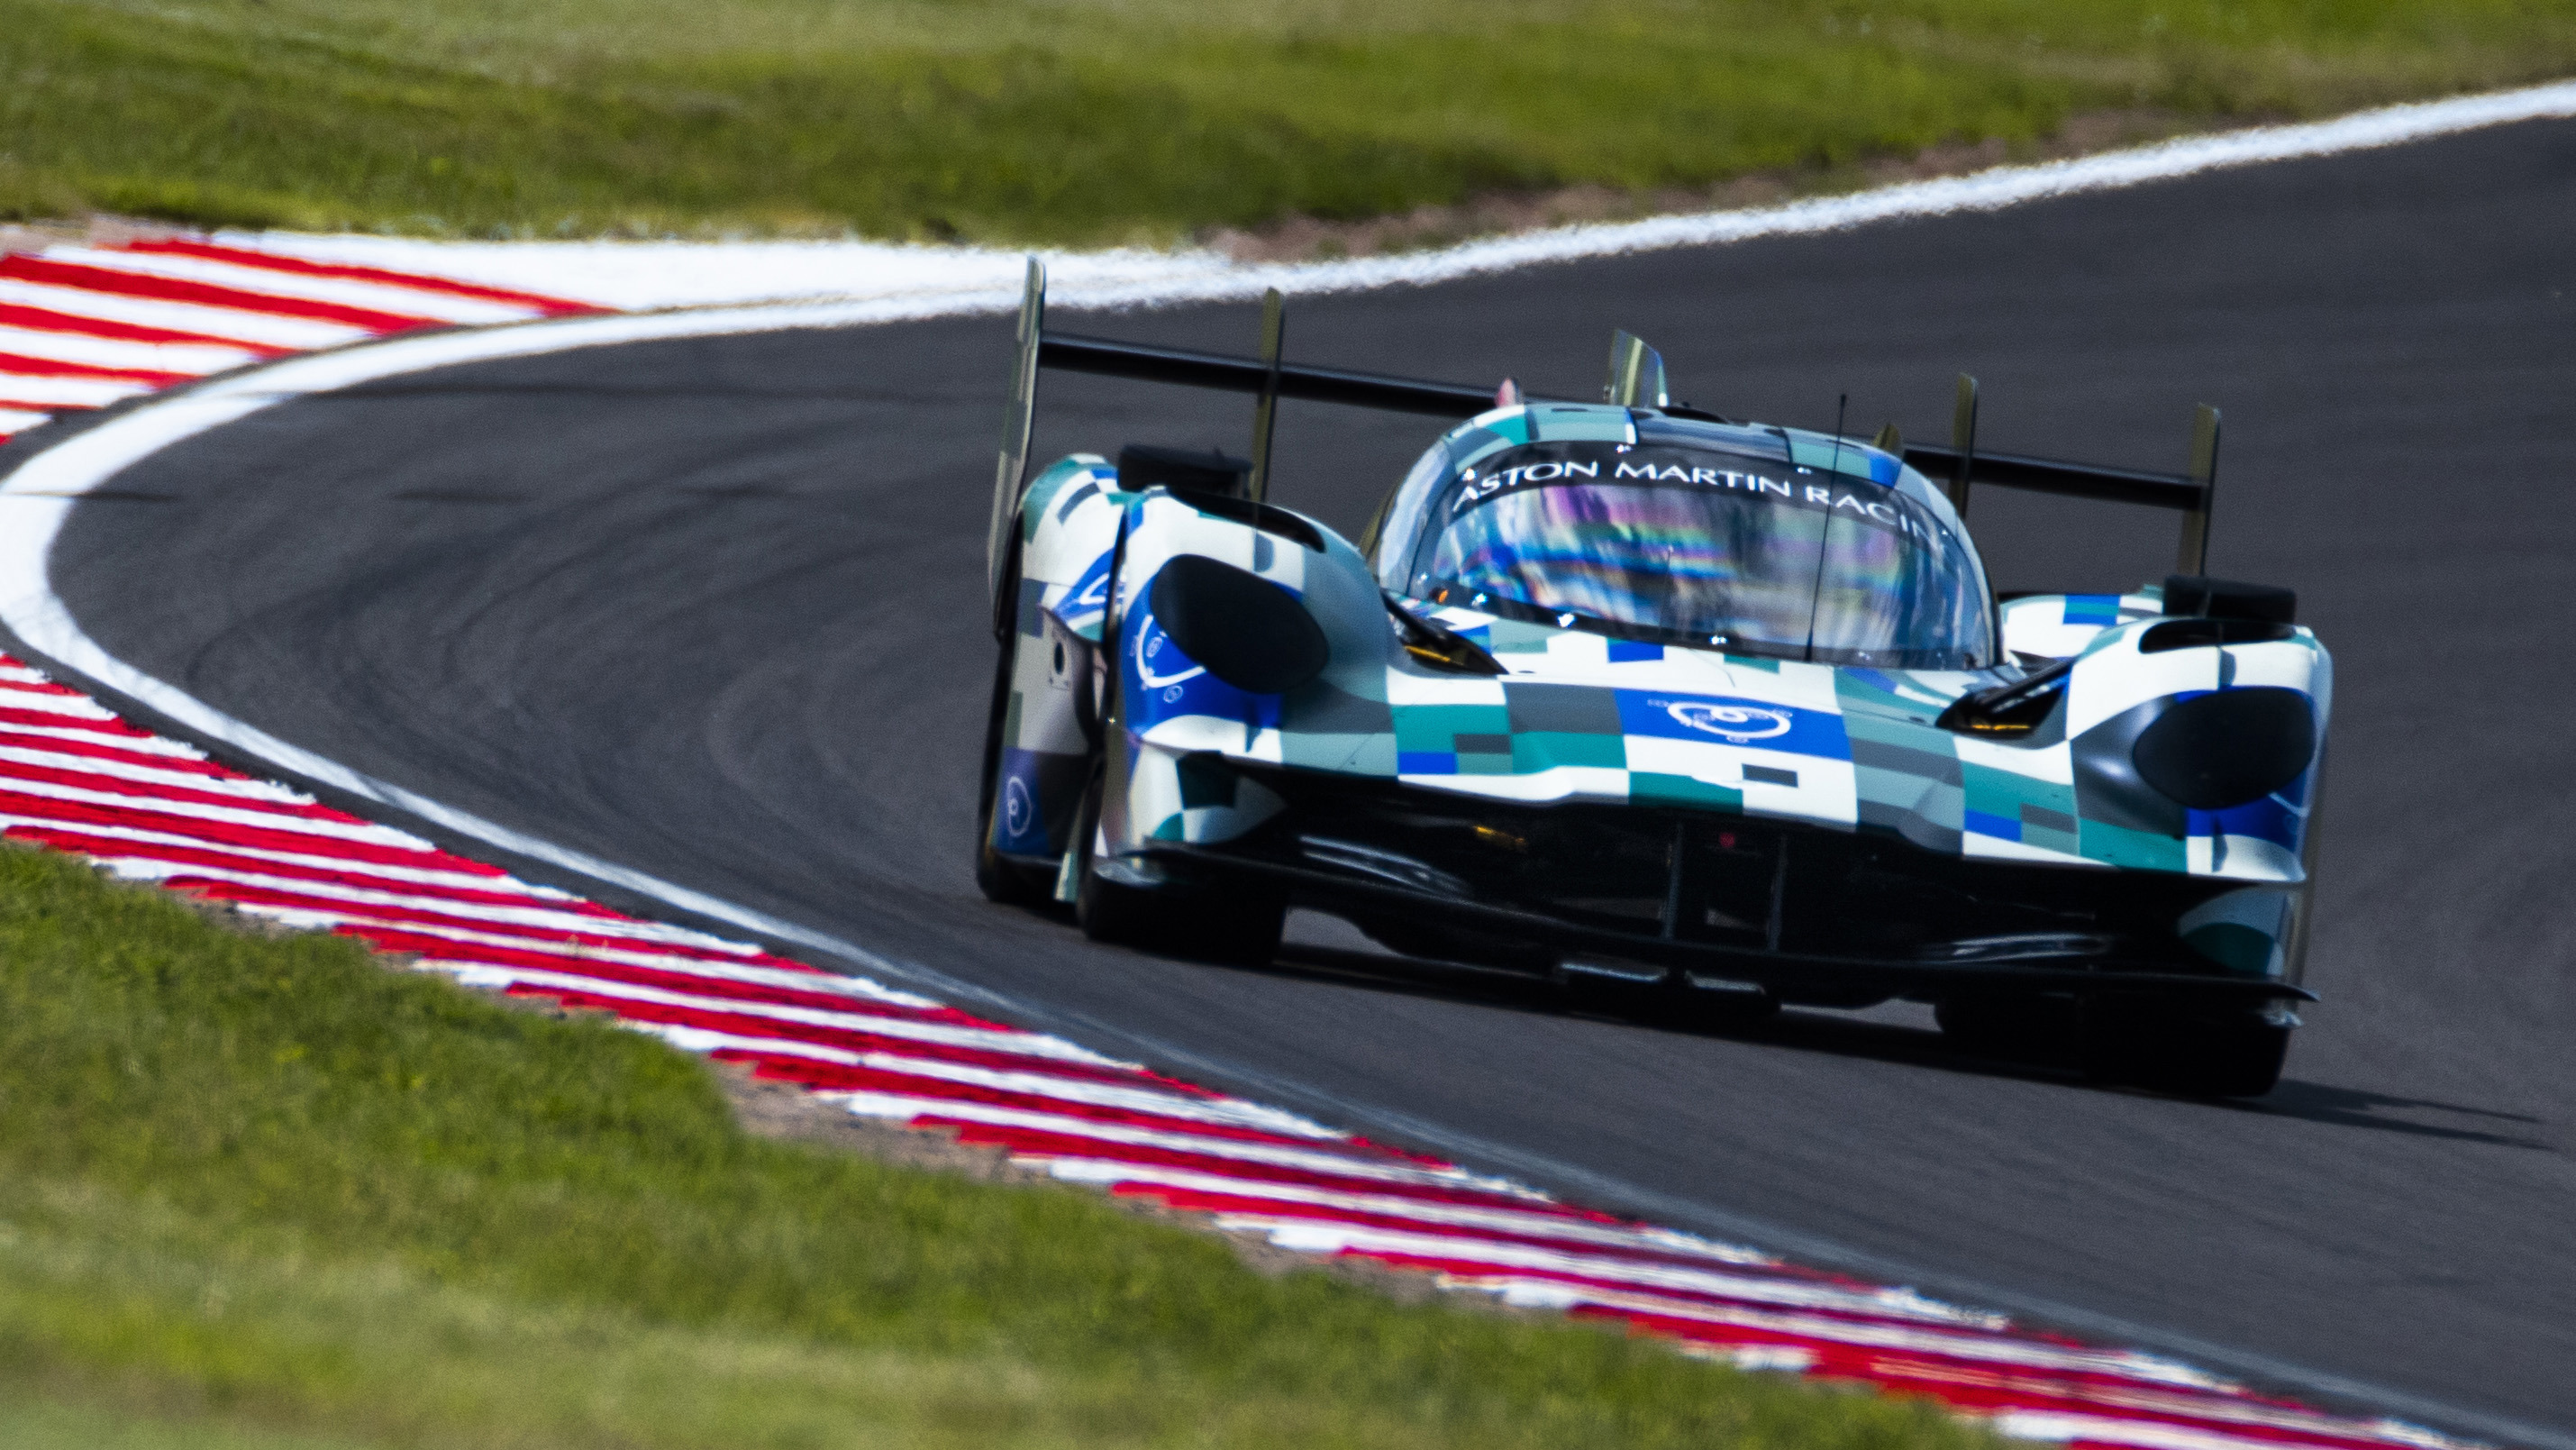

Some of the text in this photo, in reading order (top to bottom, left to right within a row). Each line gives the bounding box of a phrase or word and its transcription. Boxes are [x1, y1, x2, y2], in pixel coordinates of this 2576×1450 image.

[1452, 461, 1936, 546] ASTON MARTIN RACIN
